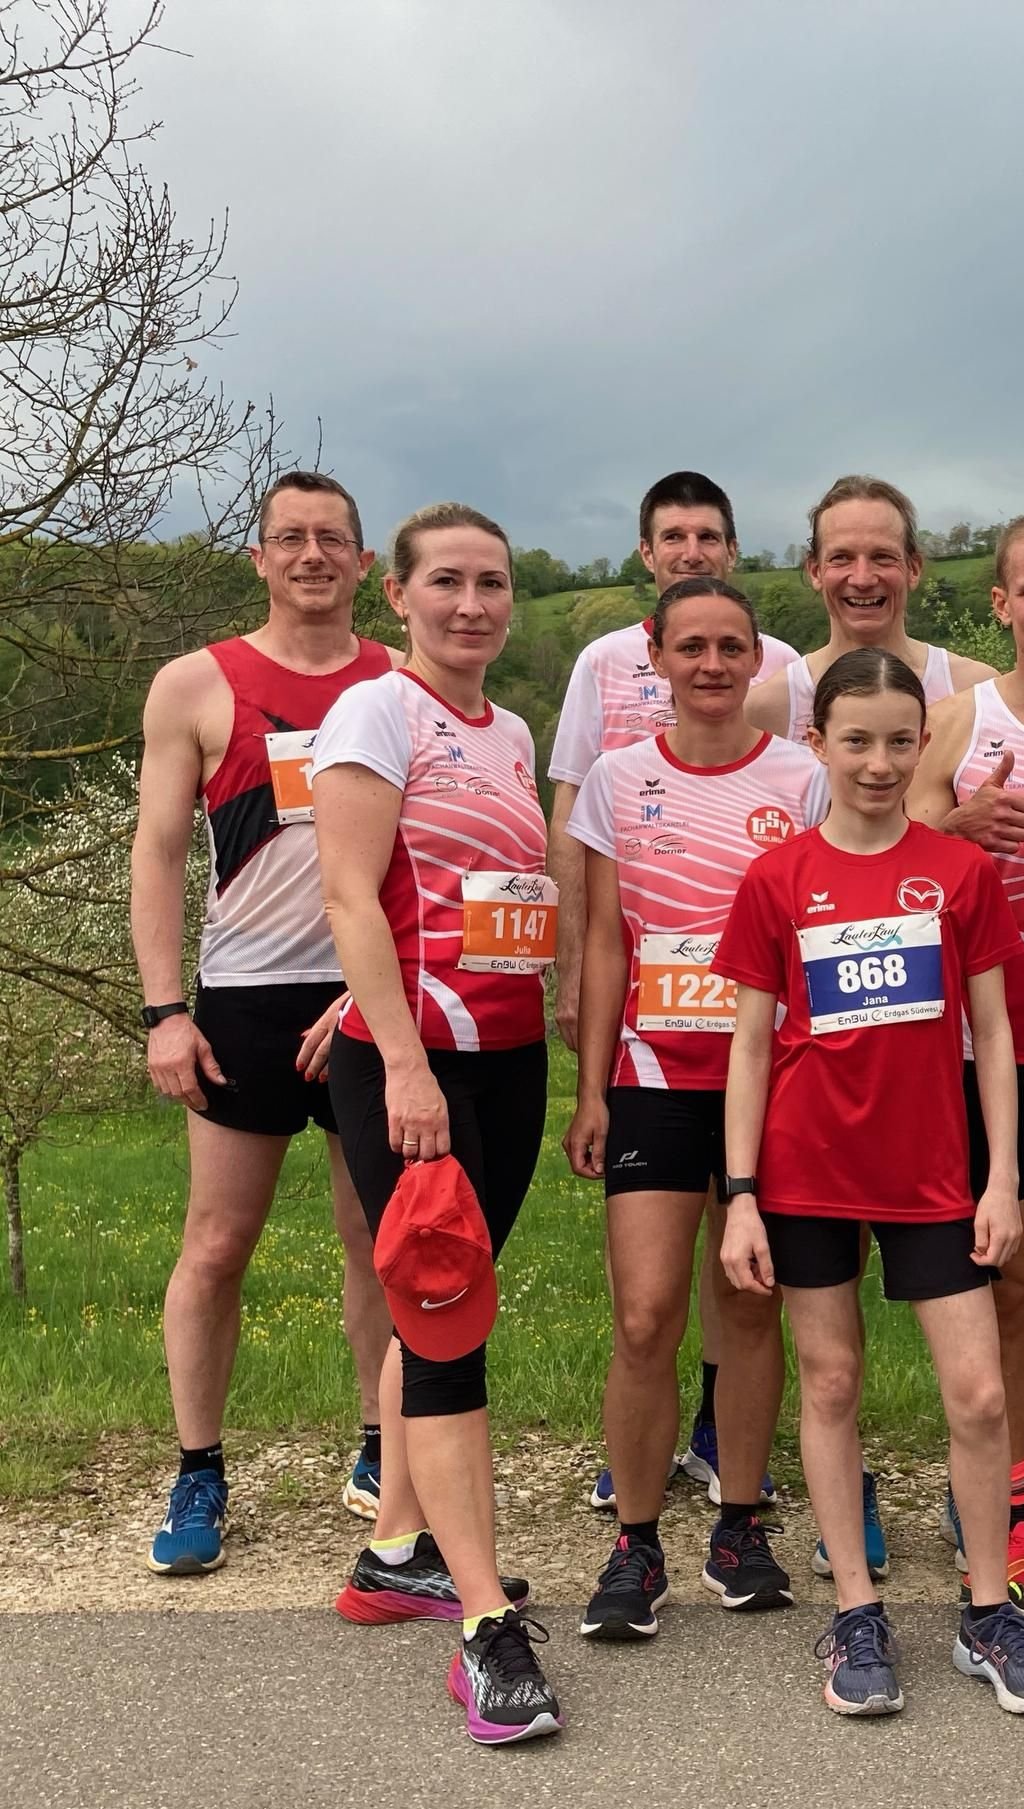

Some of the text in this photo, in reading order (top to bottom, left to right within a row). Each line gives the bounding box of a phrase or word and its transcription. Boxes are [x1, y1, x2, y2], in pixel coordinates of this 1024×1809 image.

[632, 671, 656, 679] erima
[639, 788, 666, 797] erima
[806, 903, 835, 914] erima
[491, 907, 548, 941] 1147
[490, 959, 516, 969] EnBW
[837, 953, 907, 994] 868
[657, 973, 738, 1009] 1223
[862, 995, 889, 1007] Jana
[837, 1013, 868, 1026] EnBW
[884, 1009, 909, 1019] Erdgas
[664, 1019, 693, 1028] EnBW
[706, 1020, 730, 1030] Erdgas
